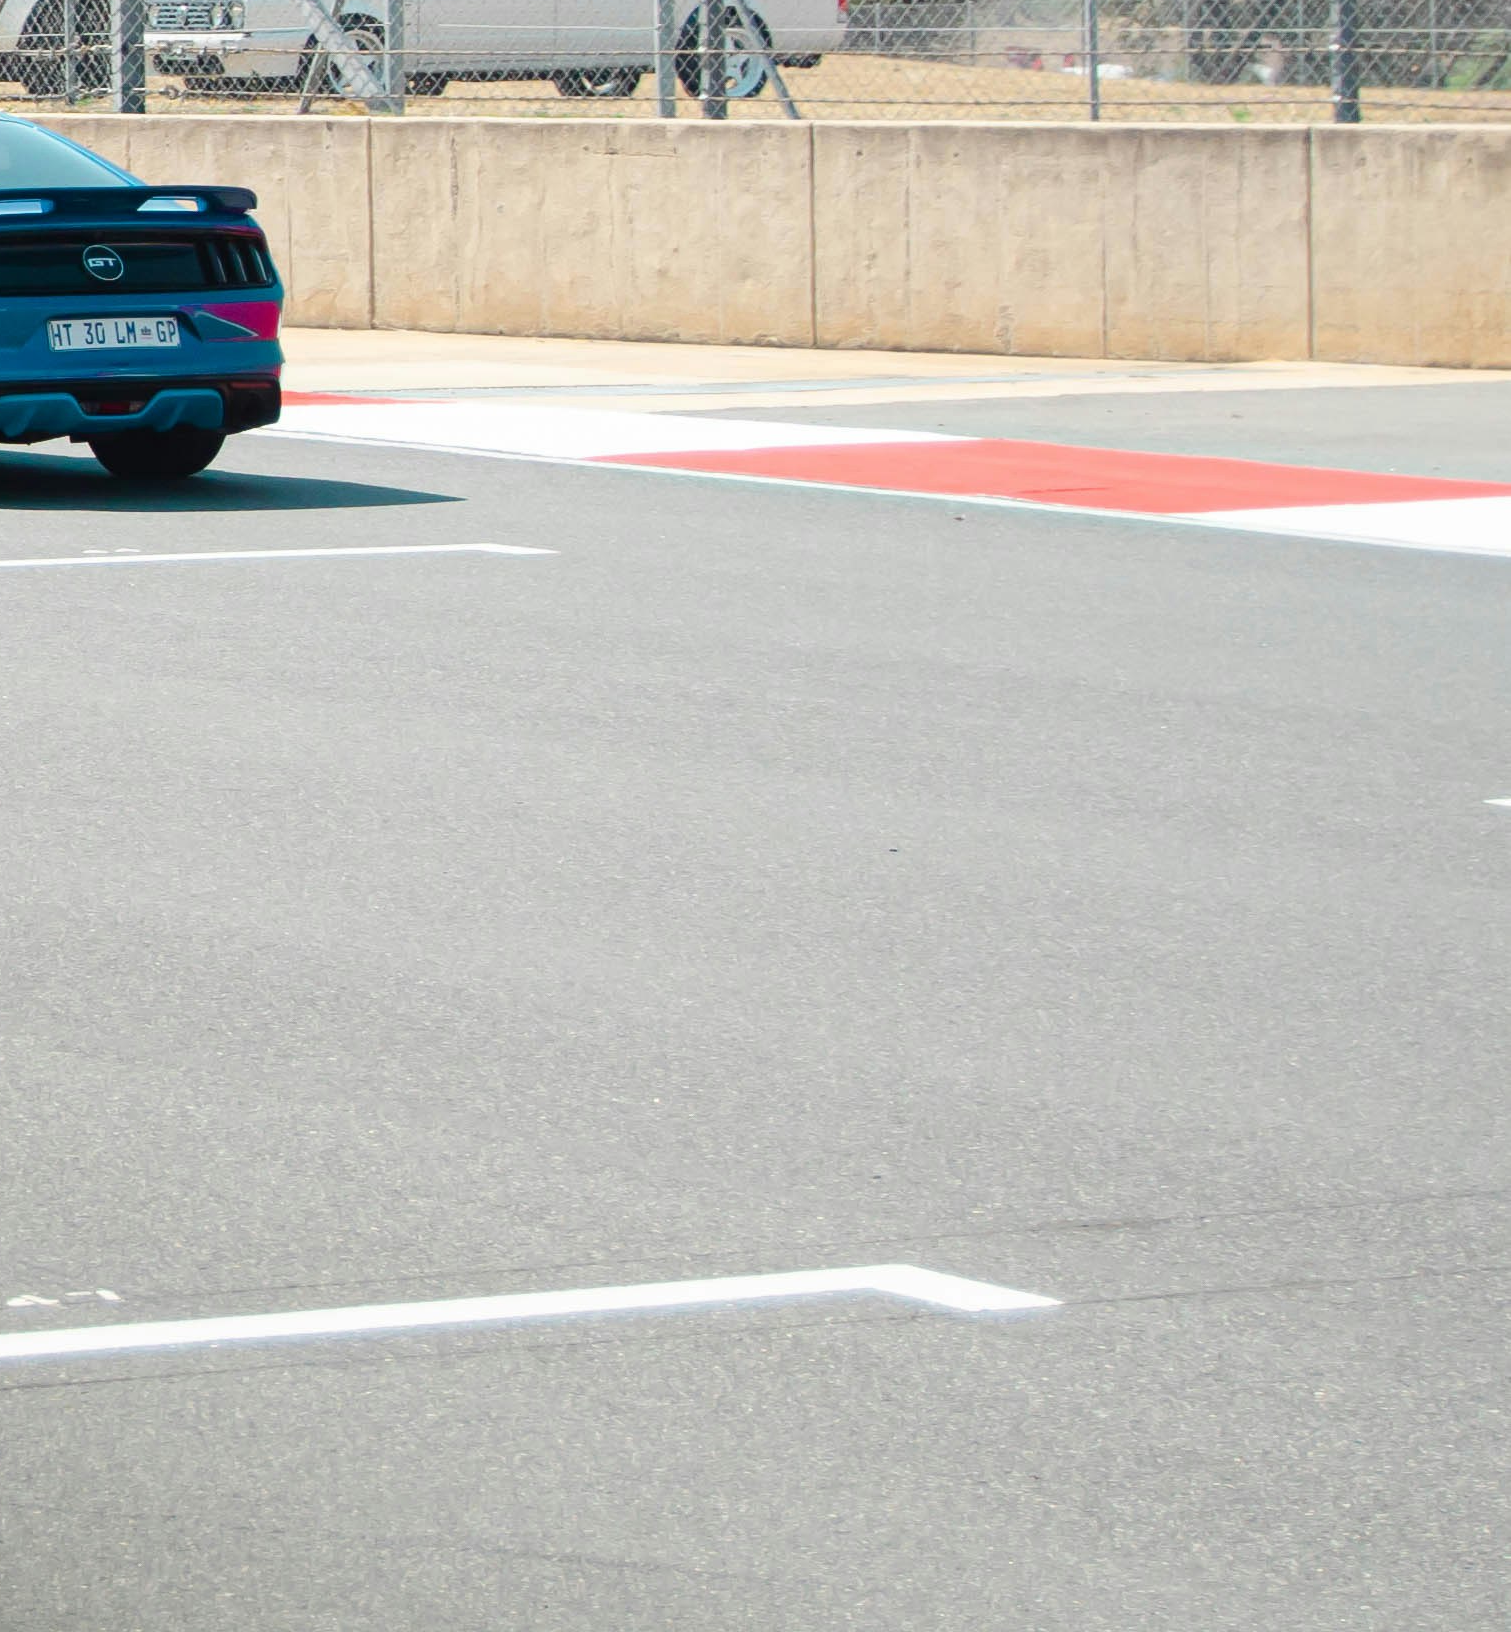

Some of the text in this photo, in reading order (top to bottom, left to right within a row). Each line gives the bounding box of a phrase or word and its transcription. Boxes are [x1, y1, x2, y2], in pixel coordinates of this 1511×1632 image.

[87, 257, 118, 268] GT
[50, 320, 177, 347] HT 30 LM GP
